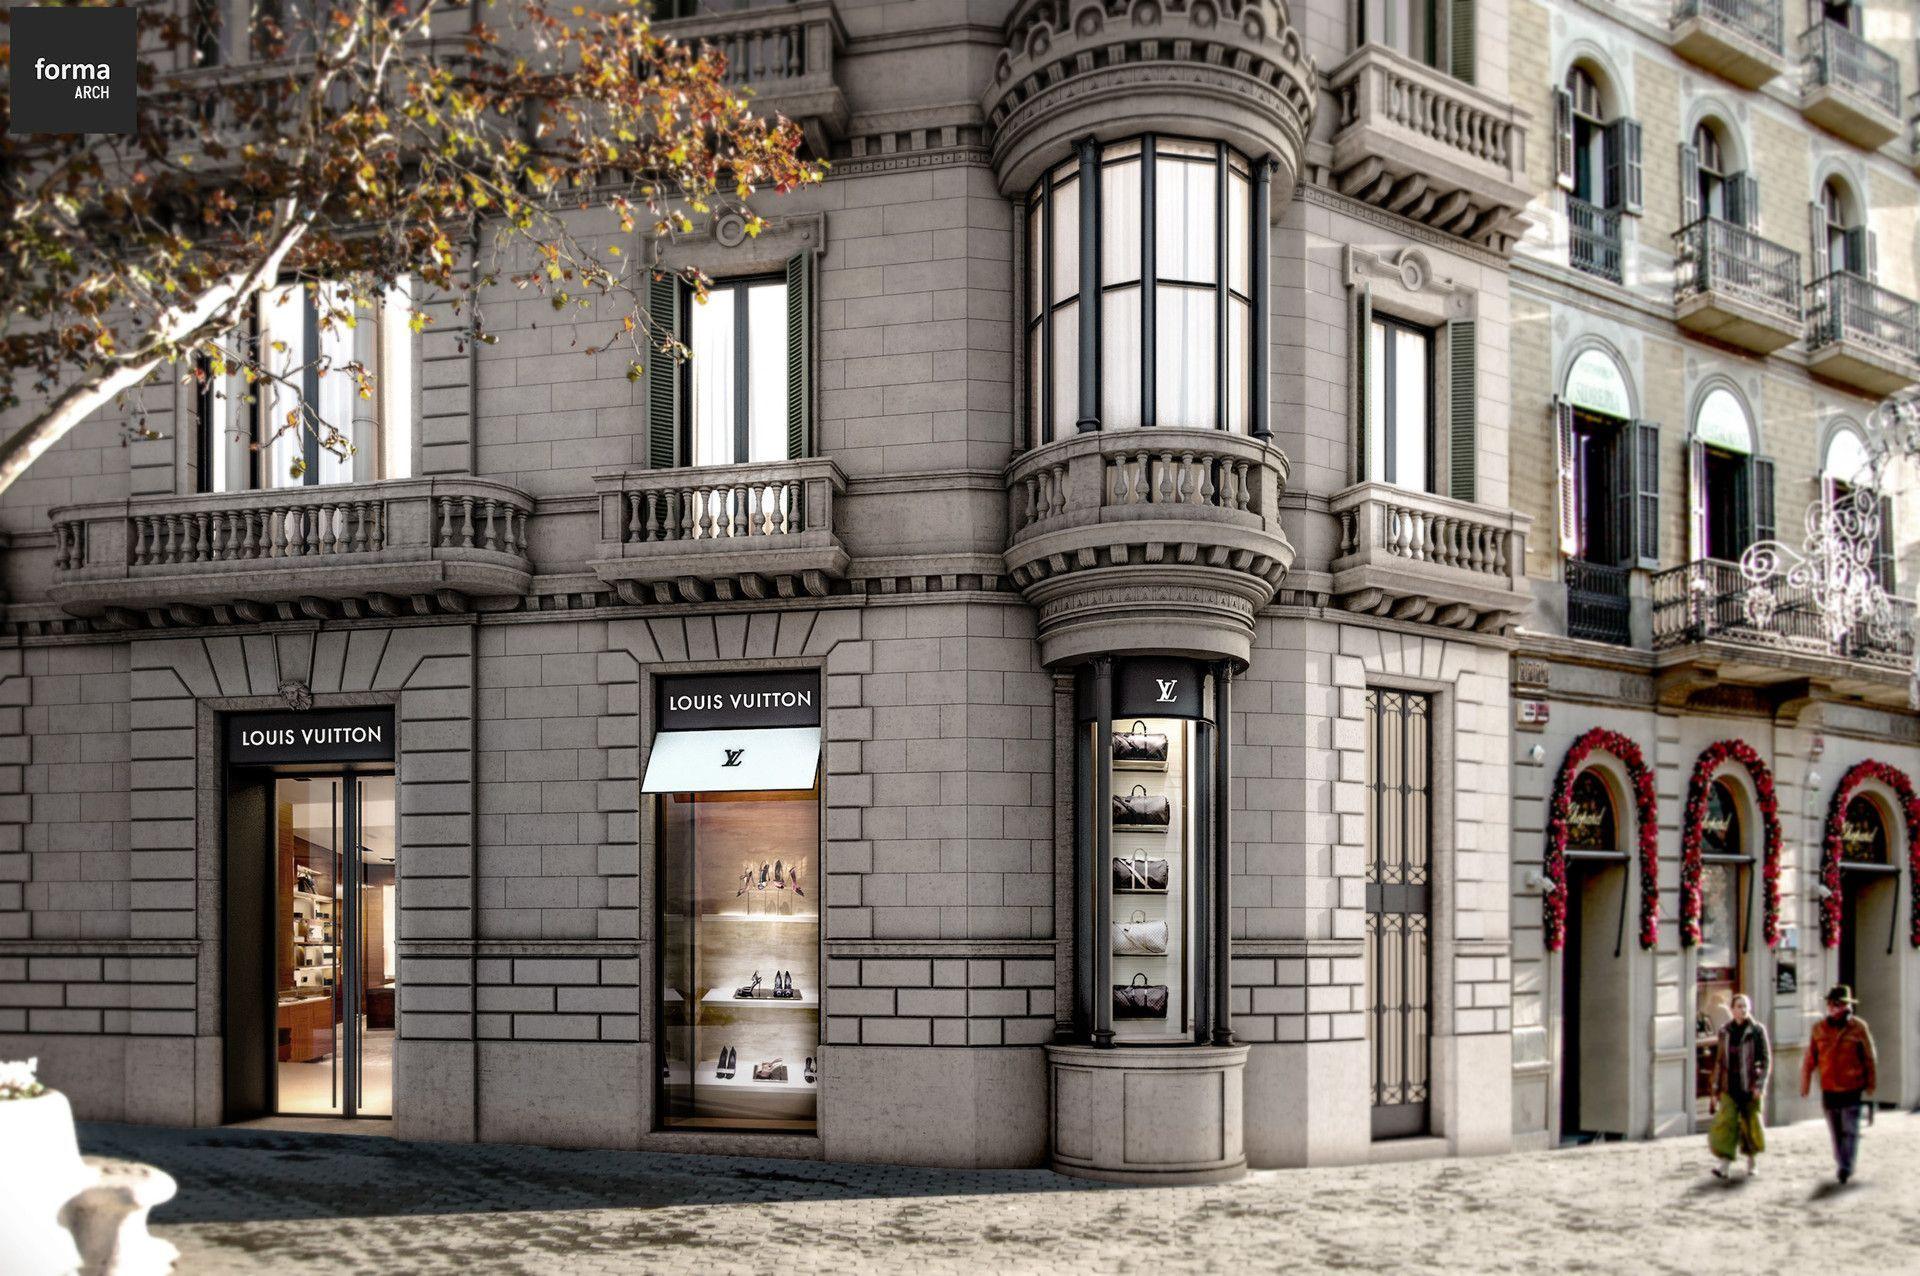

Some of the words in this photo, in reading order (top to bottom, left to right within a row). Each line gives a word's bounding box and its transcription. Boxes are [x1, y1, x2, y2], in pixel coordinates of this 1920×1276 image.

[670, 694, 723, 711] LOUIS
[730, 690, 811, 709] VUITTON
[1156, 679, 1178, 703] LV
[242, 729, 295, 746] LOUIS
[302, 725, 382, 745] VUITTON
[721, 749, 745, 767] LV
[1701, 810, 1732, 834] hopard
